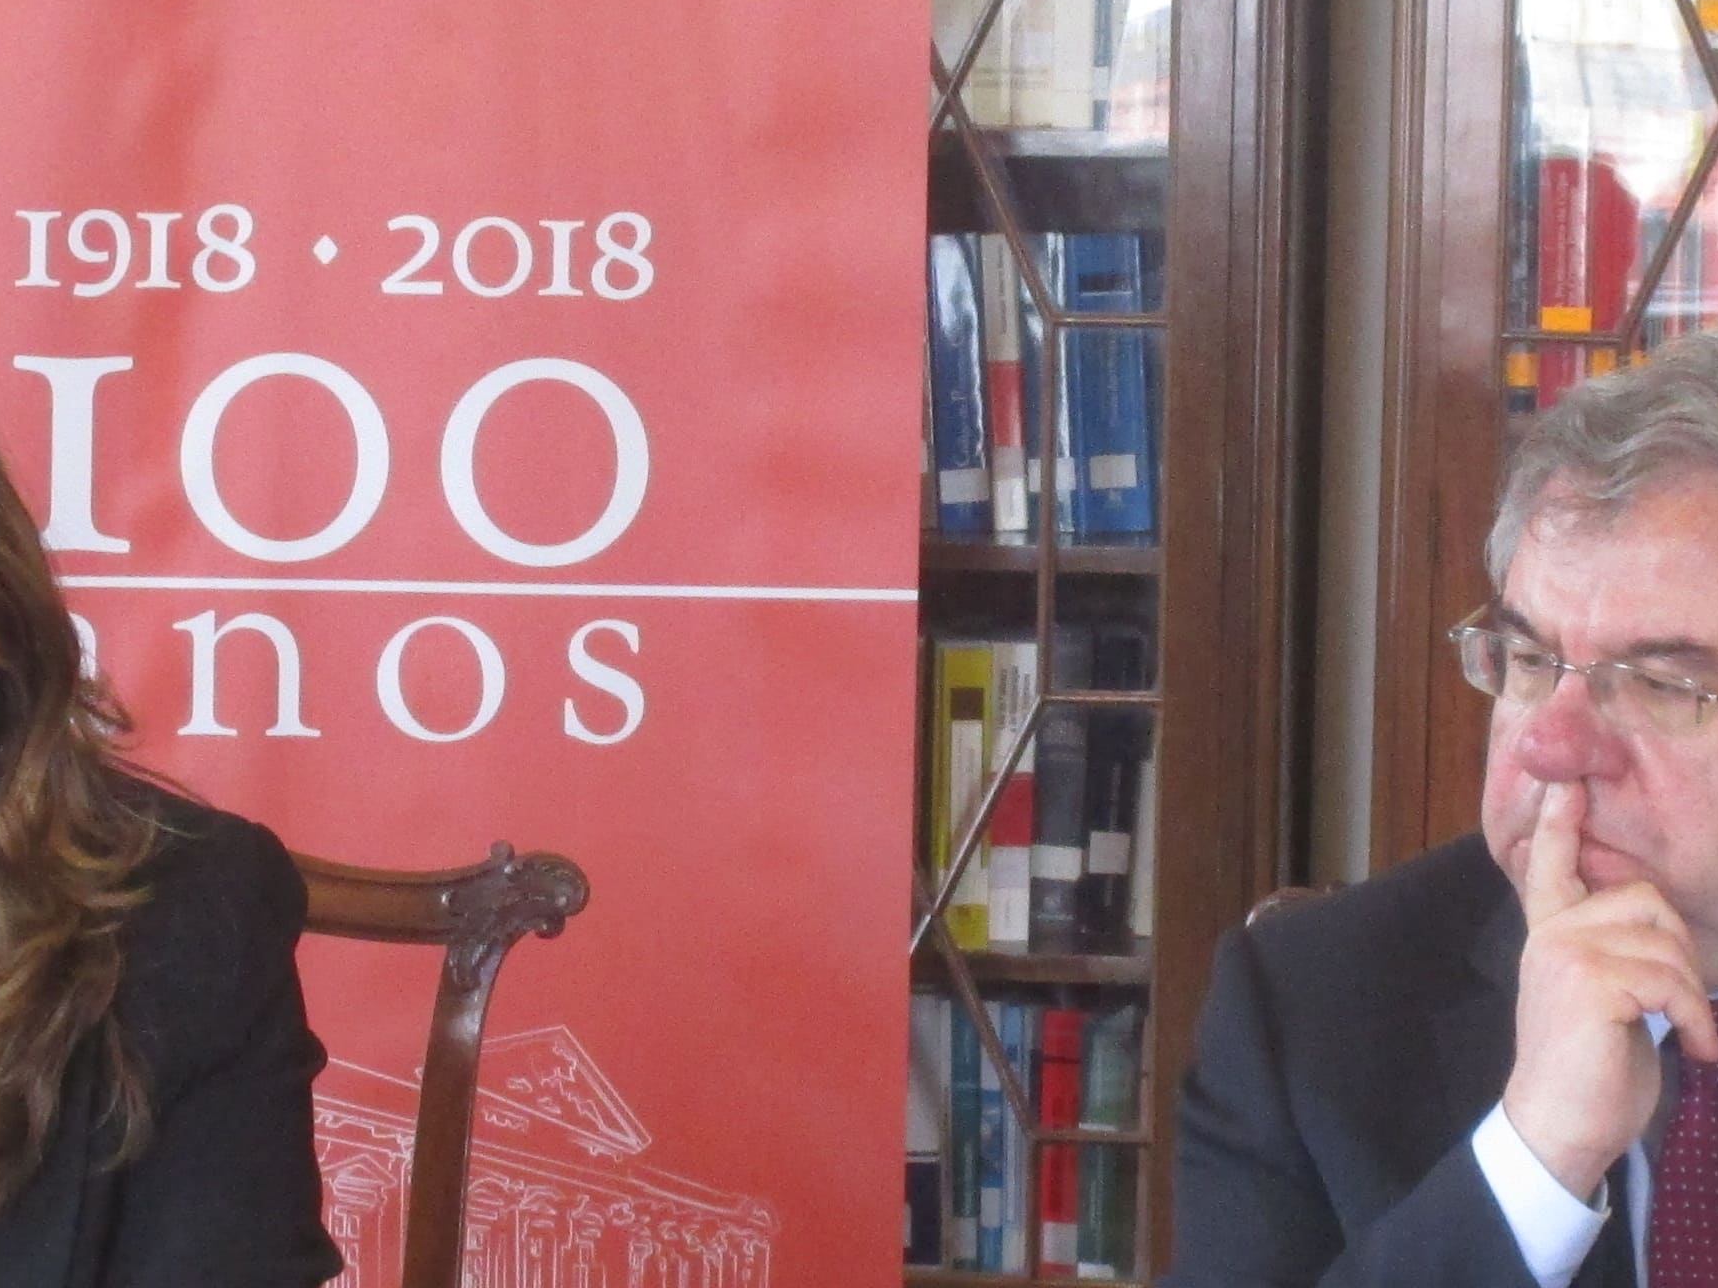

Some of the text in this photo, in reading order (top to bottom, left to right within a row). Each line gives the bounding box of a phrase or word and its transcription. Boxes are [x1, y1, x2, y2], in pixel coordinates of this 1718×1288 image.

[14, 203, 258, 300] 1918
[380, 211, 657, 303] 2018
[12, 352, 652, 570] 100
[68, 609, 647, 747] nos
